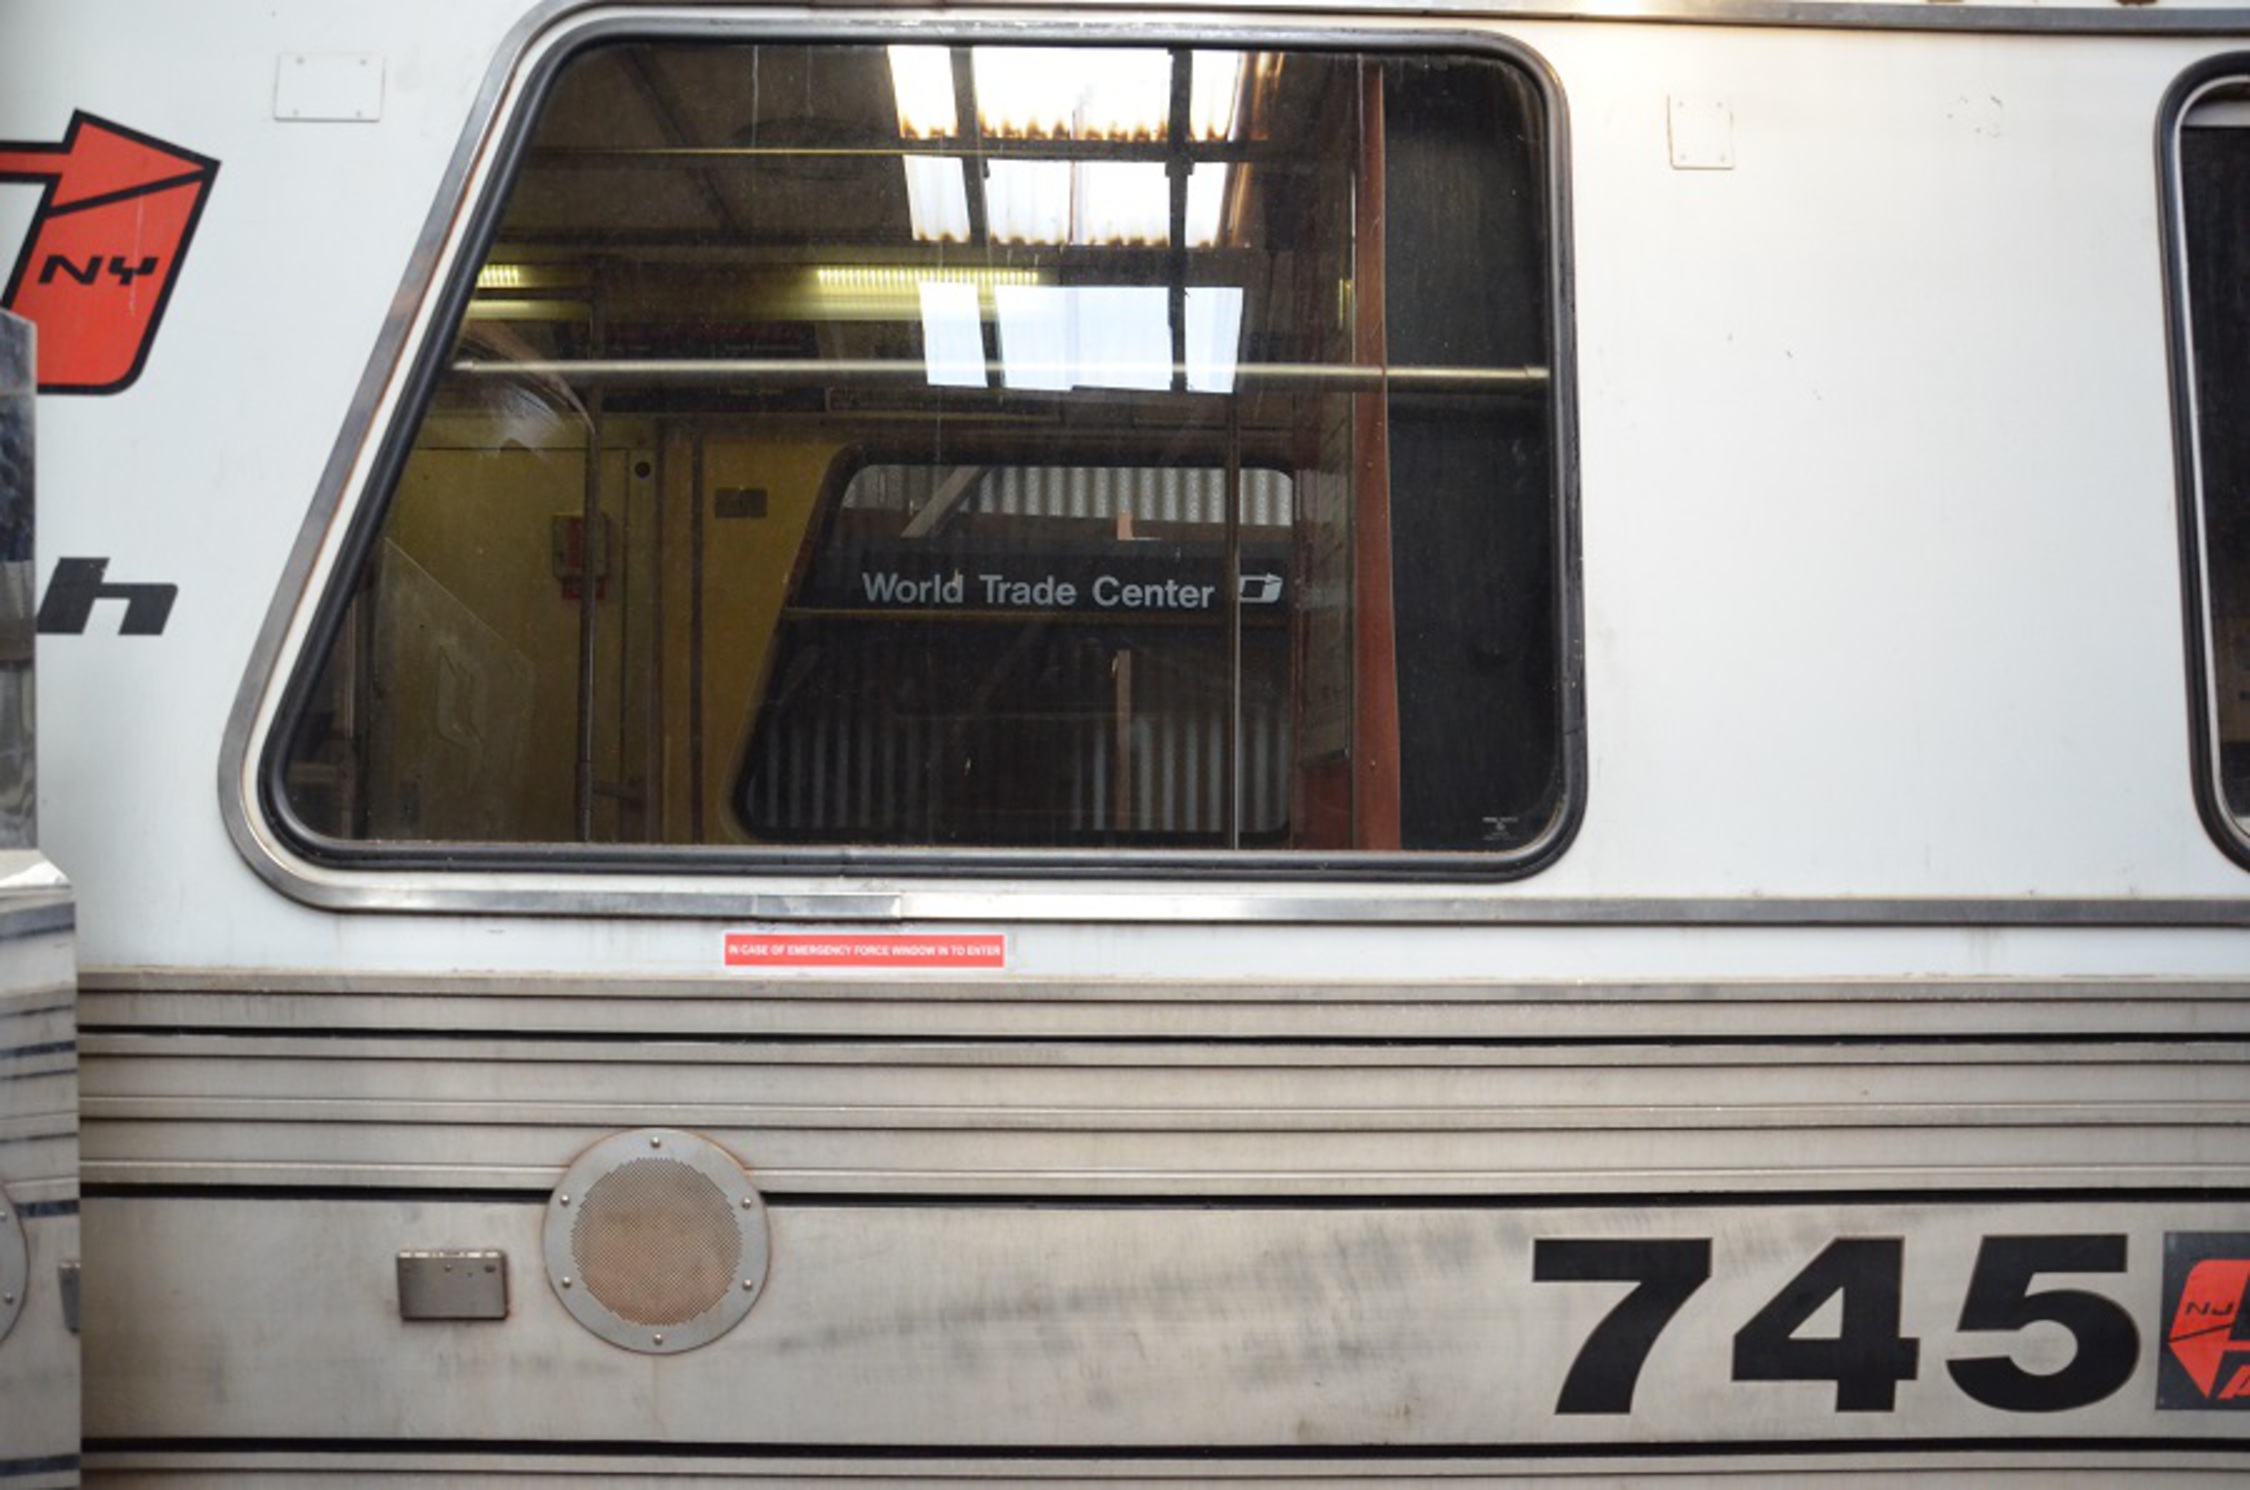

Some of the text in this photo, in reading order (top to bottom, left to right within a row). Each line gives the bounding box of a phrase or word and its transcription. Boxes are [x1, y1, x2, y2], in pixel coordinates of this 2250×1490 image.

[38, 253, 159, 286] NY
[862, 572, 1215, 609] World Trade Center
[728, 945, 1001, 956] IN CASE OF EMERGENCY FORCE WINDOW IN TO ENTER
[1532, 1233, 2140, 1415] 745
[2186, 1301, 2235, 1316] NJ
